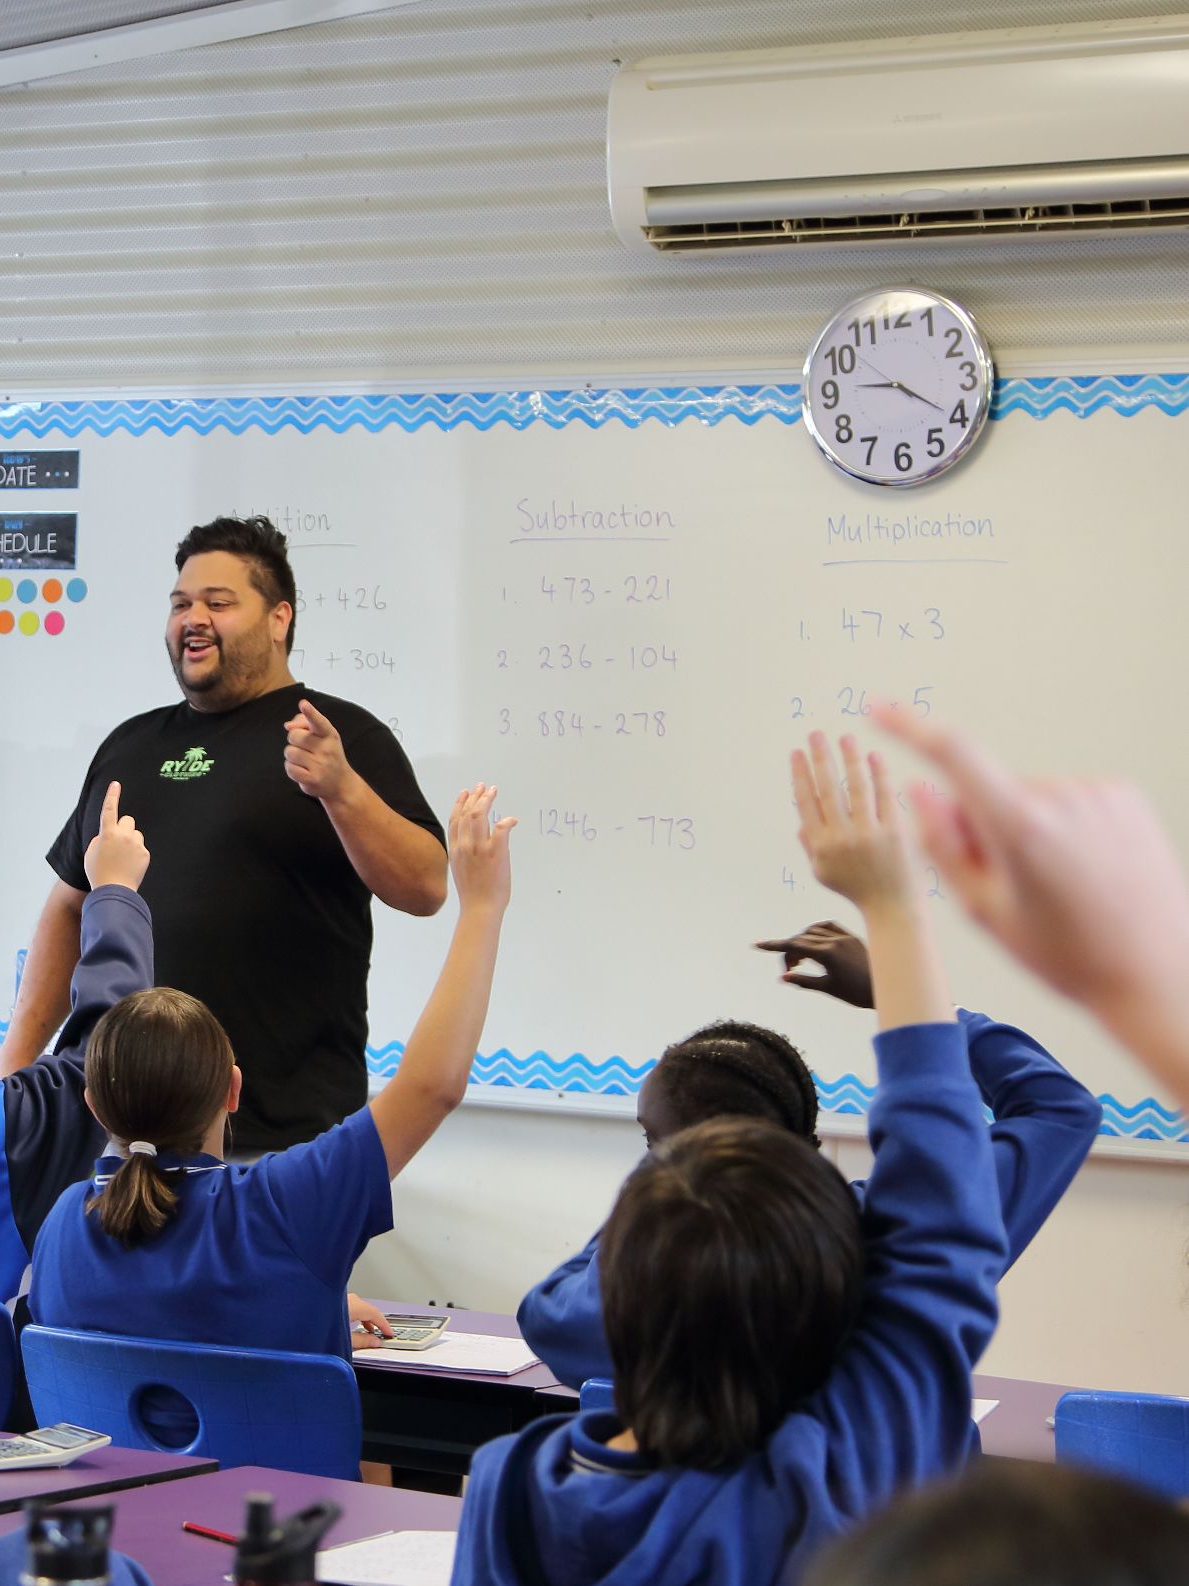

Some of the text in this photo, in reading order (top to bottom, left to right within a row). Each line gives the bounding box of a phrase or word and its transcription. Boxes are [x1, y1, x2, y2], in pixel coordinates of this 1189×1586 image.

[847, 315, 877, 347] 11
[920, 307, 934, 337] 1
[943, 327, 964, 358] 2
[824, 344, 856, 376] 10
[958, 360, 978, 392] 3
[820, 379, 840, 410] 9
[834, 414, 853, 444] 8
[949, 399, 970, 429] 4
[860, 436, 879, 466] 7
[893, 442, 913, 472] 6
[926, 427, 945, 458] 5
[516, 498, 676, 533] Subtraction
[826, 514, 996, 546] Multiplication
[338, 584, 387, 611] 426
[541, 575, 595, 605] 473
[624, 575, 671, 603] 221
[799, 619, 811, 641] 1.
[842, 607, 883, 642] 47
[923, 607, 946, 640] 3
[349, 649, 396, 673] 304
[539, 643, 593, 669] 236
[630, 644, 678, 671] 104
[912, 686, 936, 718] 5
[537, 710, 584, 737] 884
[615, 710, 668, 737] 278
[539, 807, 598, 842] 1246
[637, 815, 696, 851] 773
